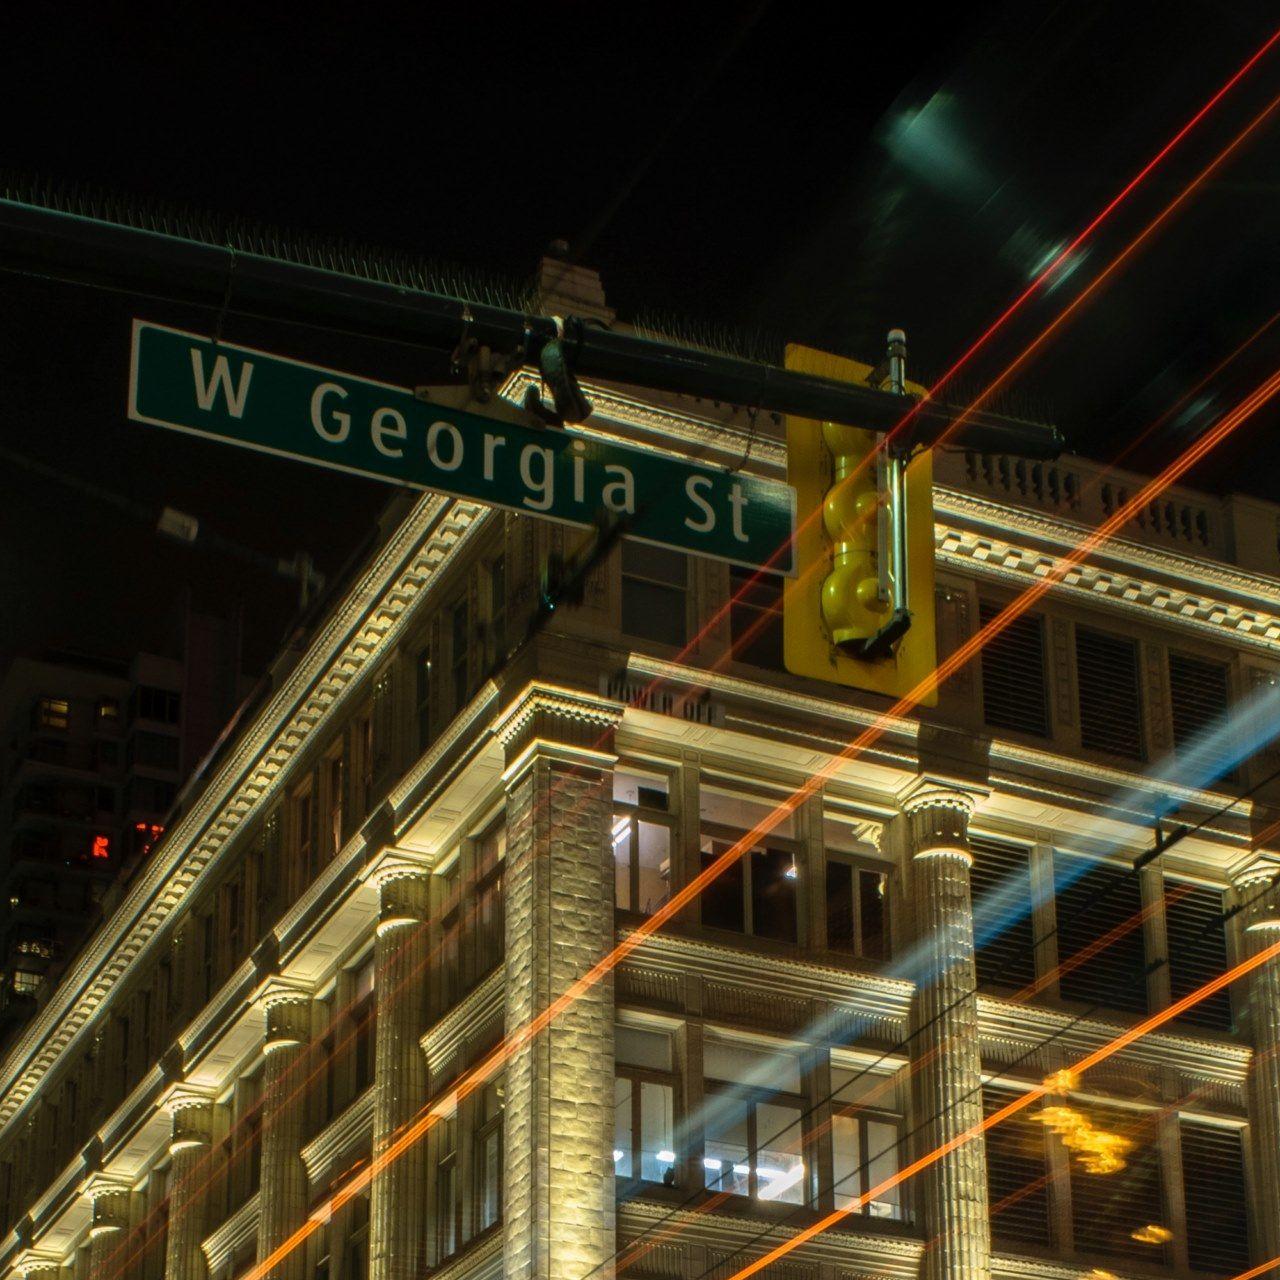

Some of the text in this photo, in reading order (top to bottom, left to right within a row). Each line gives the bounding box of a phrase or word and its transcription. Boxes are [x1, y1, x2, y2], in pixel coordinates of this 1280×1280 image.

[191, 347, 750, 542] W Georgia St
